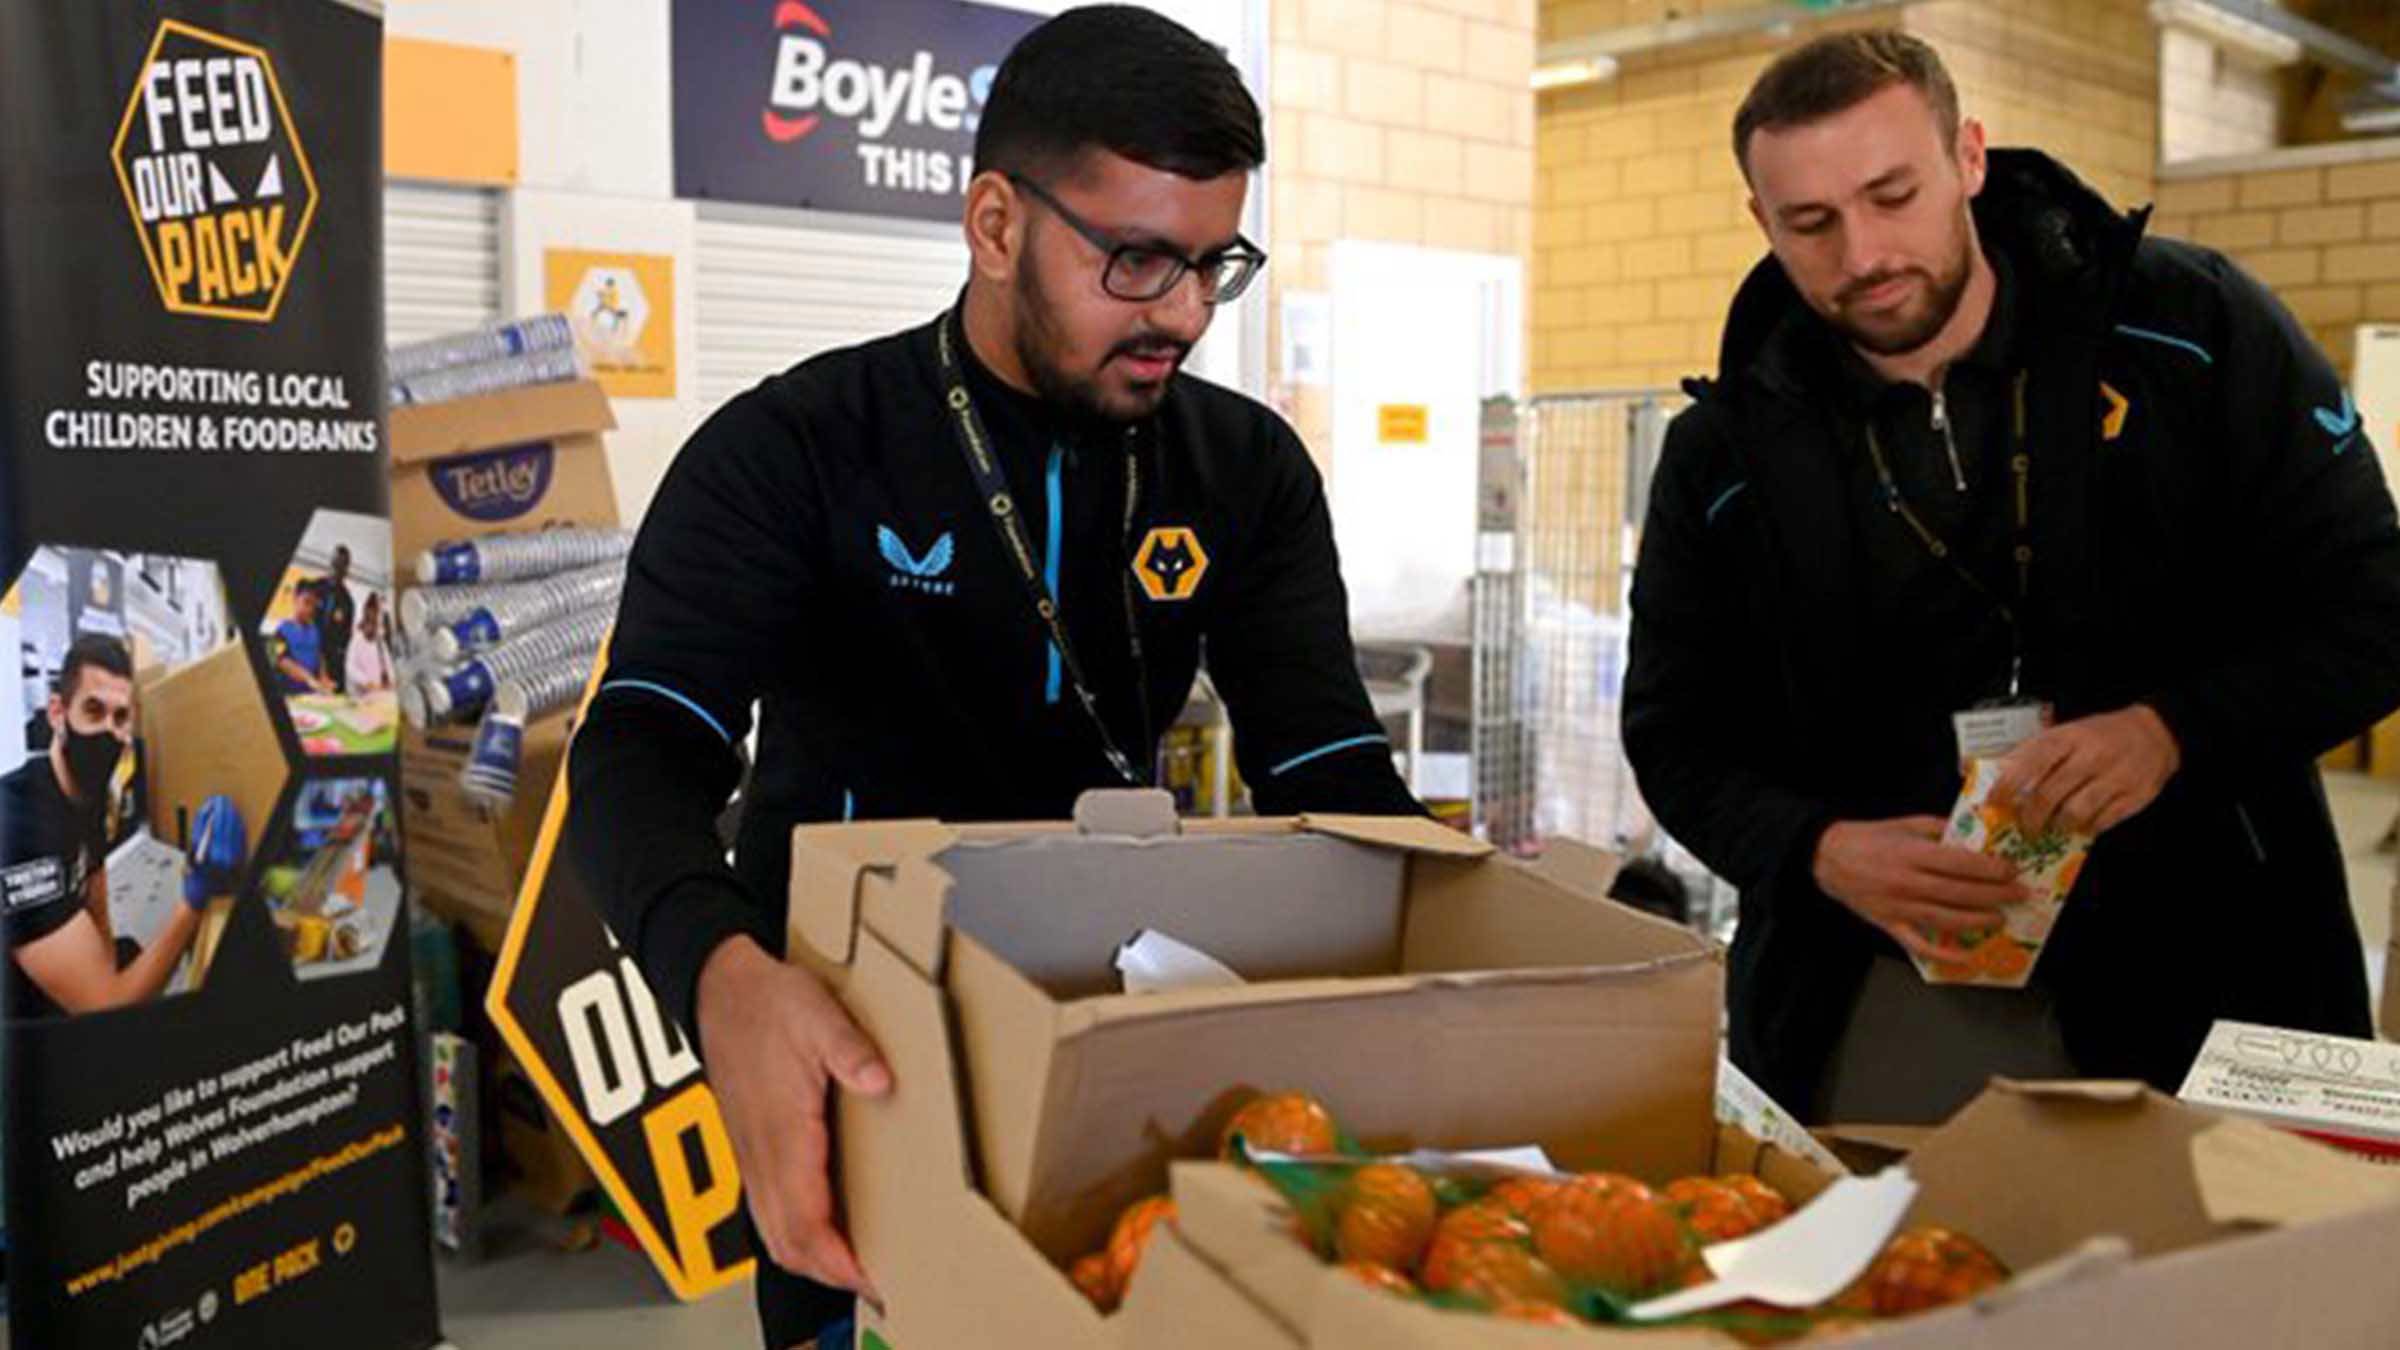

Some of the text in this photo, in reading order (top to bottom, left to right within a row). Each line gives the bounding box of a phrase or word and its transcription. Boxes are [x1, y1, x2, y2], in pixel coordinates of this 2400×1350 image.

[142, 56, 271, 152] FEED
[132, 152, 206, 222] OUR
[857, 144, 951, 194] THIS
[157, 204, 290, 303] PACK
[86, 361, 350, 410] SUPPORTING LOCAL
[45, 410, 377, 452] CHILDREN & FOODBANKS
[451, 452, 540, 501] Tetley
[51, 1004, 405, 1161] Would you like to support Feed Our Pack
[74, 1040, 394, 1189] and help Wolves Foundation support
[127, 1159, 188, 1210] people
[190, 1150, 208, 1171] in
